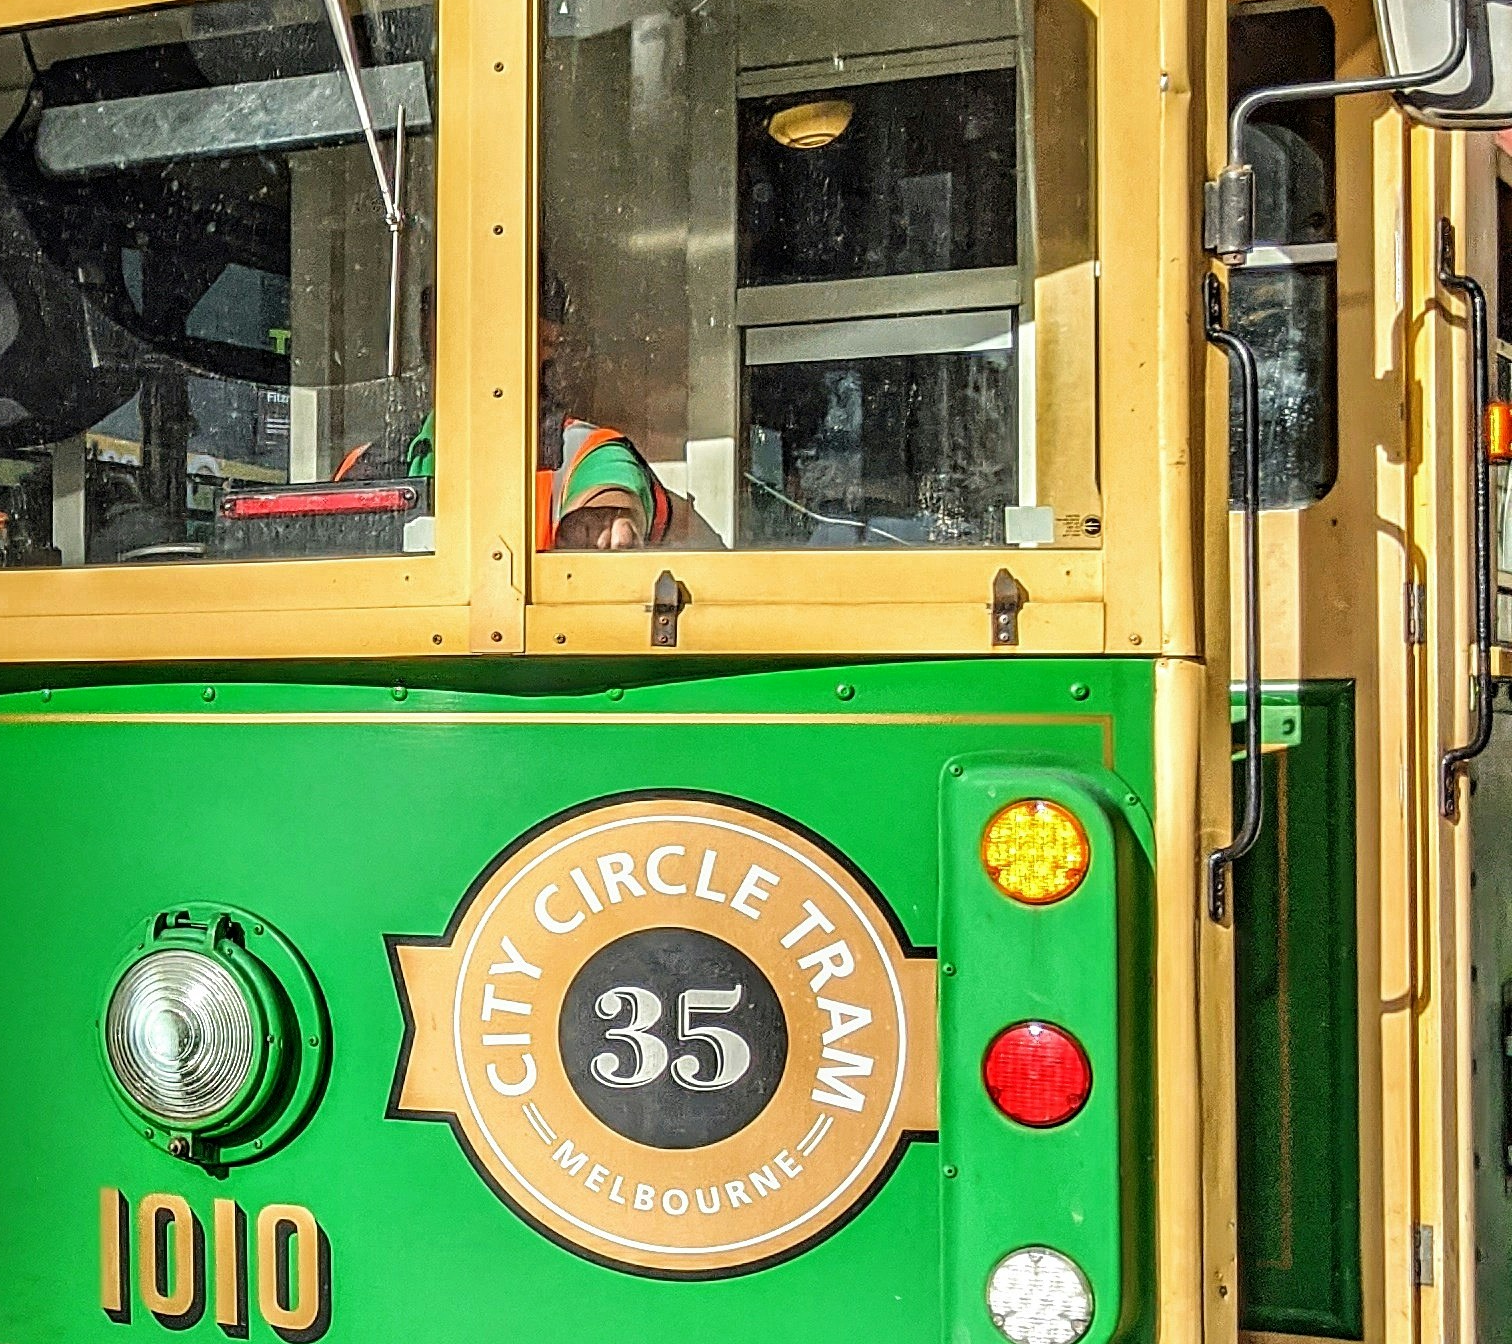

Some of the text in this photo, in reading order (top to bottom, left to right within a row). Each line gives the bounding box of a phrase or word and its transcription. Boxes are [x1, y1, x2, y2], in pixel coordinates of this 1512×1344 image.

[481, 844, 876, 1114] CITY CIRCLE TRAM
[590, 984, 752, 1091] 35
[551, 1137, 805, 1216] MELBOURNE
